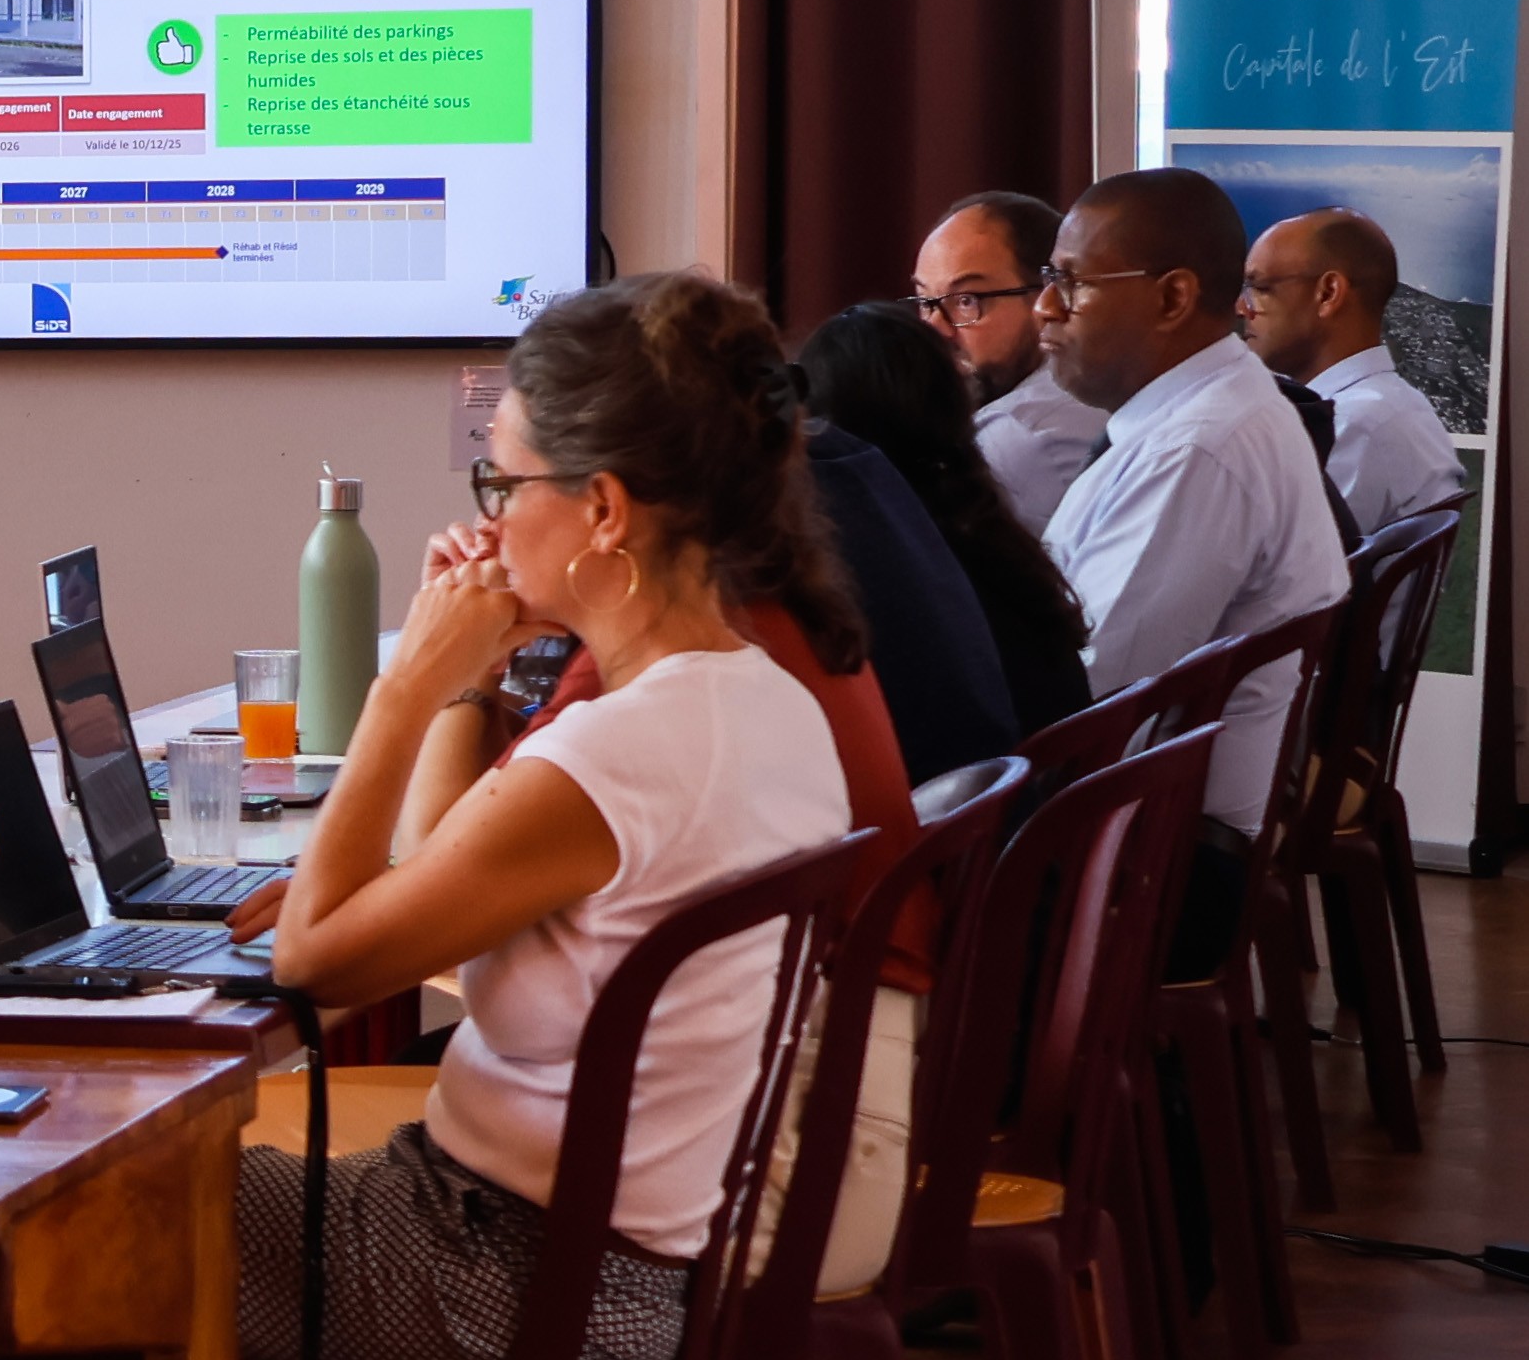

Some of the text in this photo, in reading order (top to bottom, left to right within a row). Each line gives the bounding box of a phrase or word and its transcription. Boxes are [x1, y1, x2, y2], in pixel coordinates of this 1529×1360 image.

[248, 24, 454, 41] Perméabilité des parkings
[248, 47, 483, 67] Reprise des sols et des pièces
[1224, 28, 1323, 91] Capitale
[1341, 28, 1368, 81] de
[248, 73, 316, 88] humides
[248, 94, 470, 114] Reprise des étanchéité sous
[68, 109, 163, 121] Date engagement
[248, 123, 311, 135] terrasse
[85, 139, 181, 151] Validé le 10/12/25
[60, 187, 87, 198] 2027
[207, 185, 235, 197] 2028
[356, 184, 385, 195] 2029
[233, 241, 297, 251] Réhab et Résid
[233, 253, 274, 262] terminées
